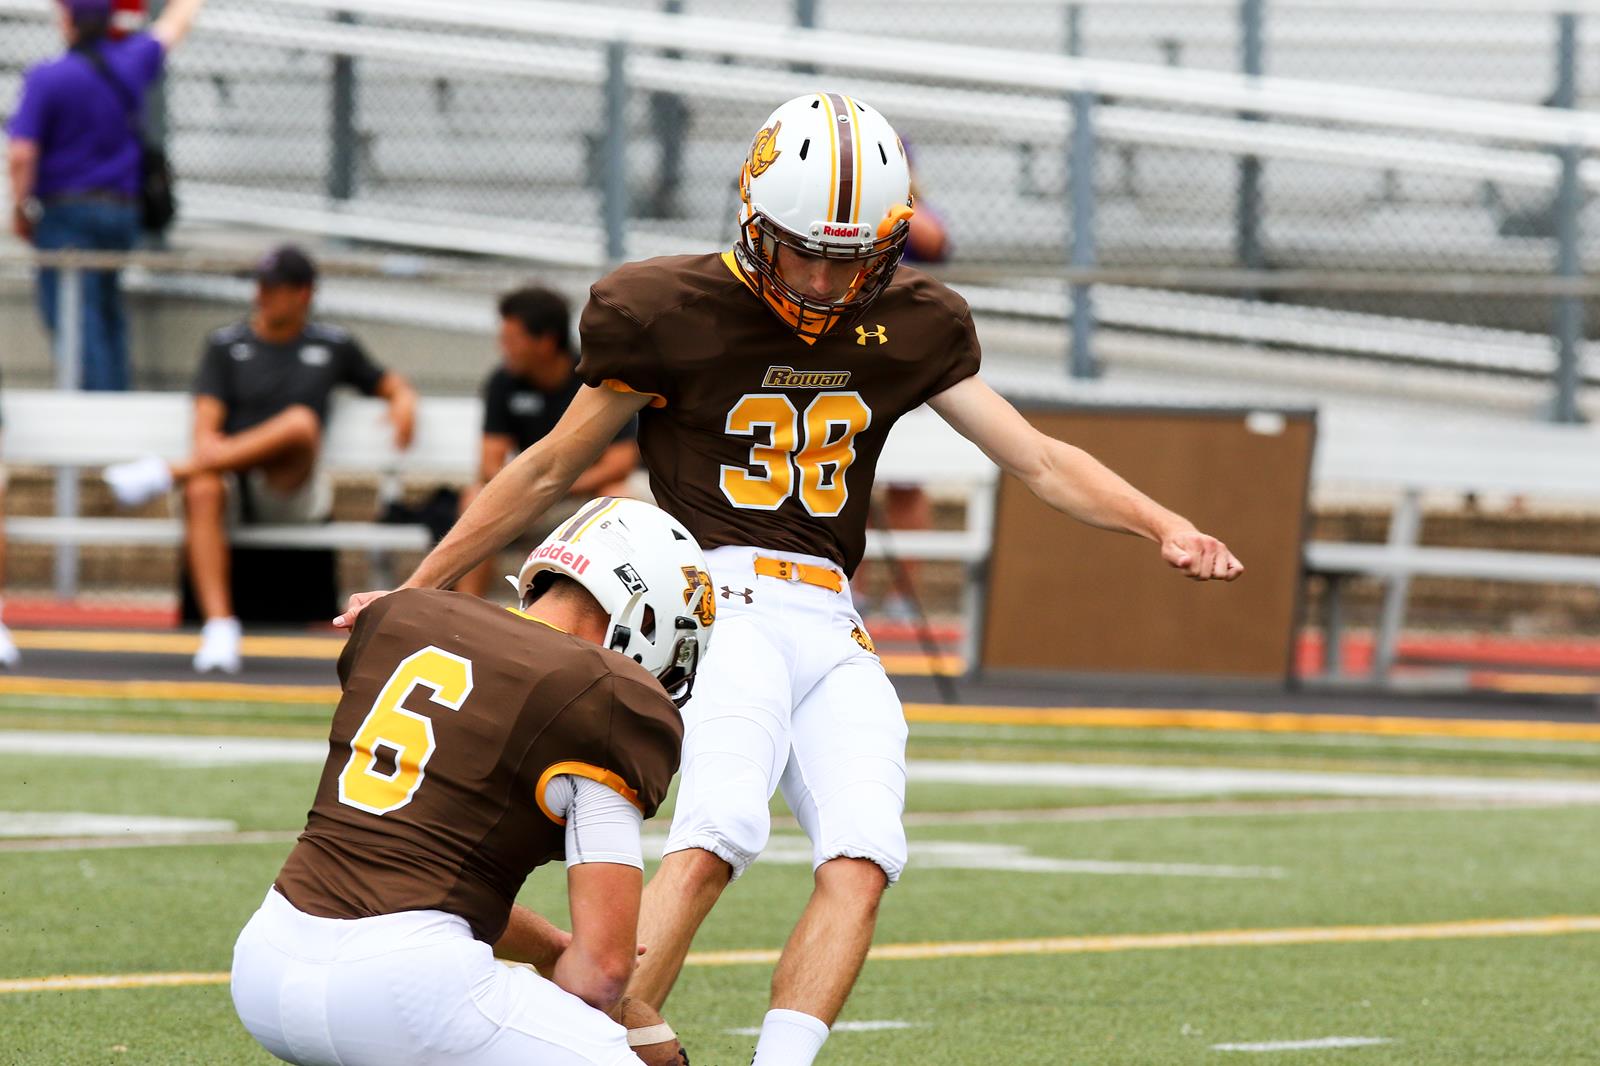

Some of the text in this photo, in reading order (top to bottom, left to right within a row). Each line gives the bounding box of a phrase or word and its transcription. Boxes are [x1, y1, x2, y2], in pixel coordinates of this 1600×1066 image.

[824, 225, 859, 237] Riddell
[762, 366, 851, 388] Rowan
[719, 391, 872, 517] 38
[600, 520, 612, 530] 6
[338, 645, 474, 816] 6
